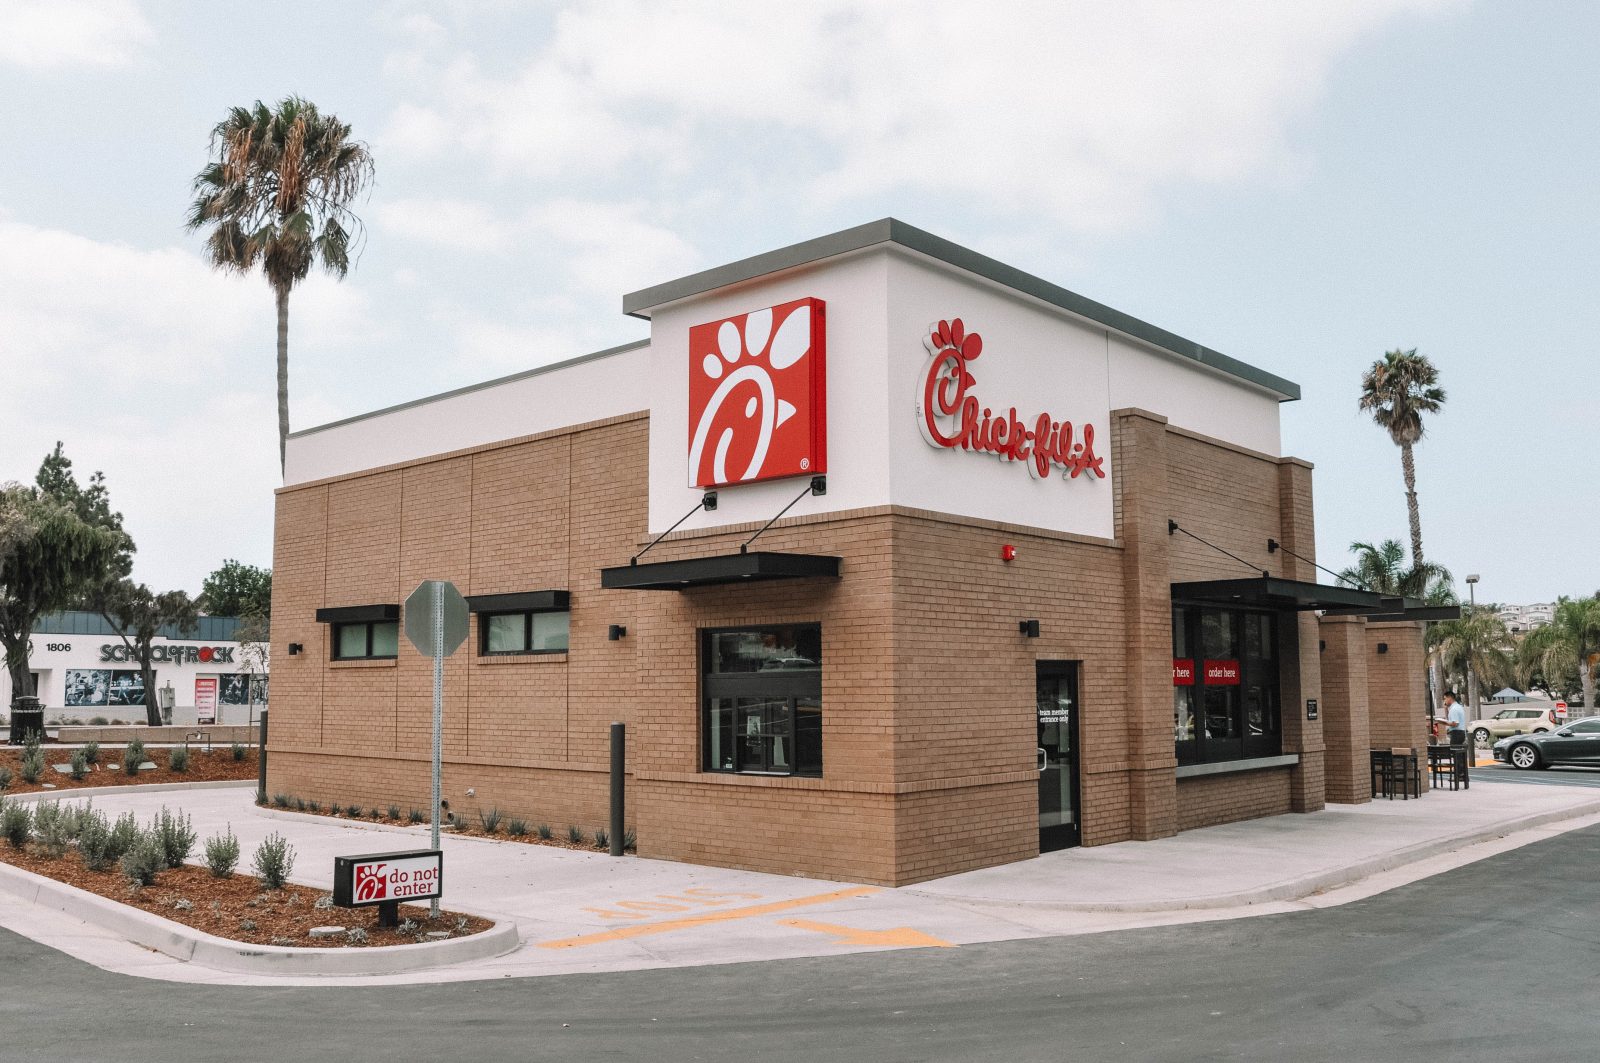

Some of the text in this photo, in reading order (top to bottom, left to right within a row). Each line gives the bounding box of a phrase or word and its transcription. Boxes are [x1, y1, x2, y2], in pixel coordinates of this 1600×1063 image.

[923, 346, 1106, 479] Chick-fil-A
[47, 643, 71, 652] 1806
[100, 644, 172, 664] SCHOL
[184, 645, 236, 664] ROCK
[1176, 667, 1190, 678] here
[1208, 667, 1236, 678] order here
[389, 866, 439, 884] do not
[393, 881, 434, 897] enter
